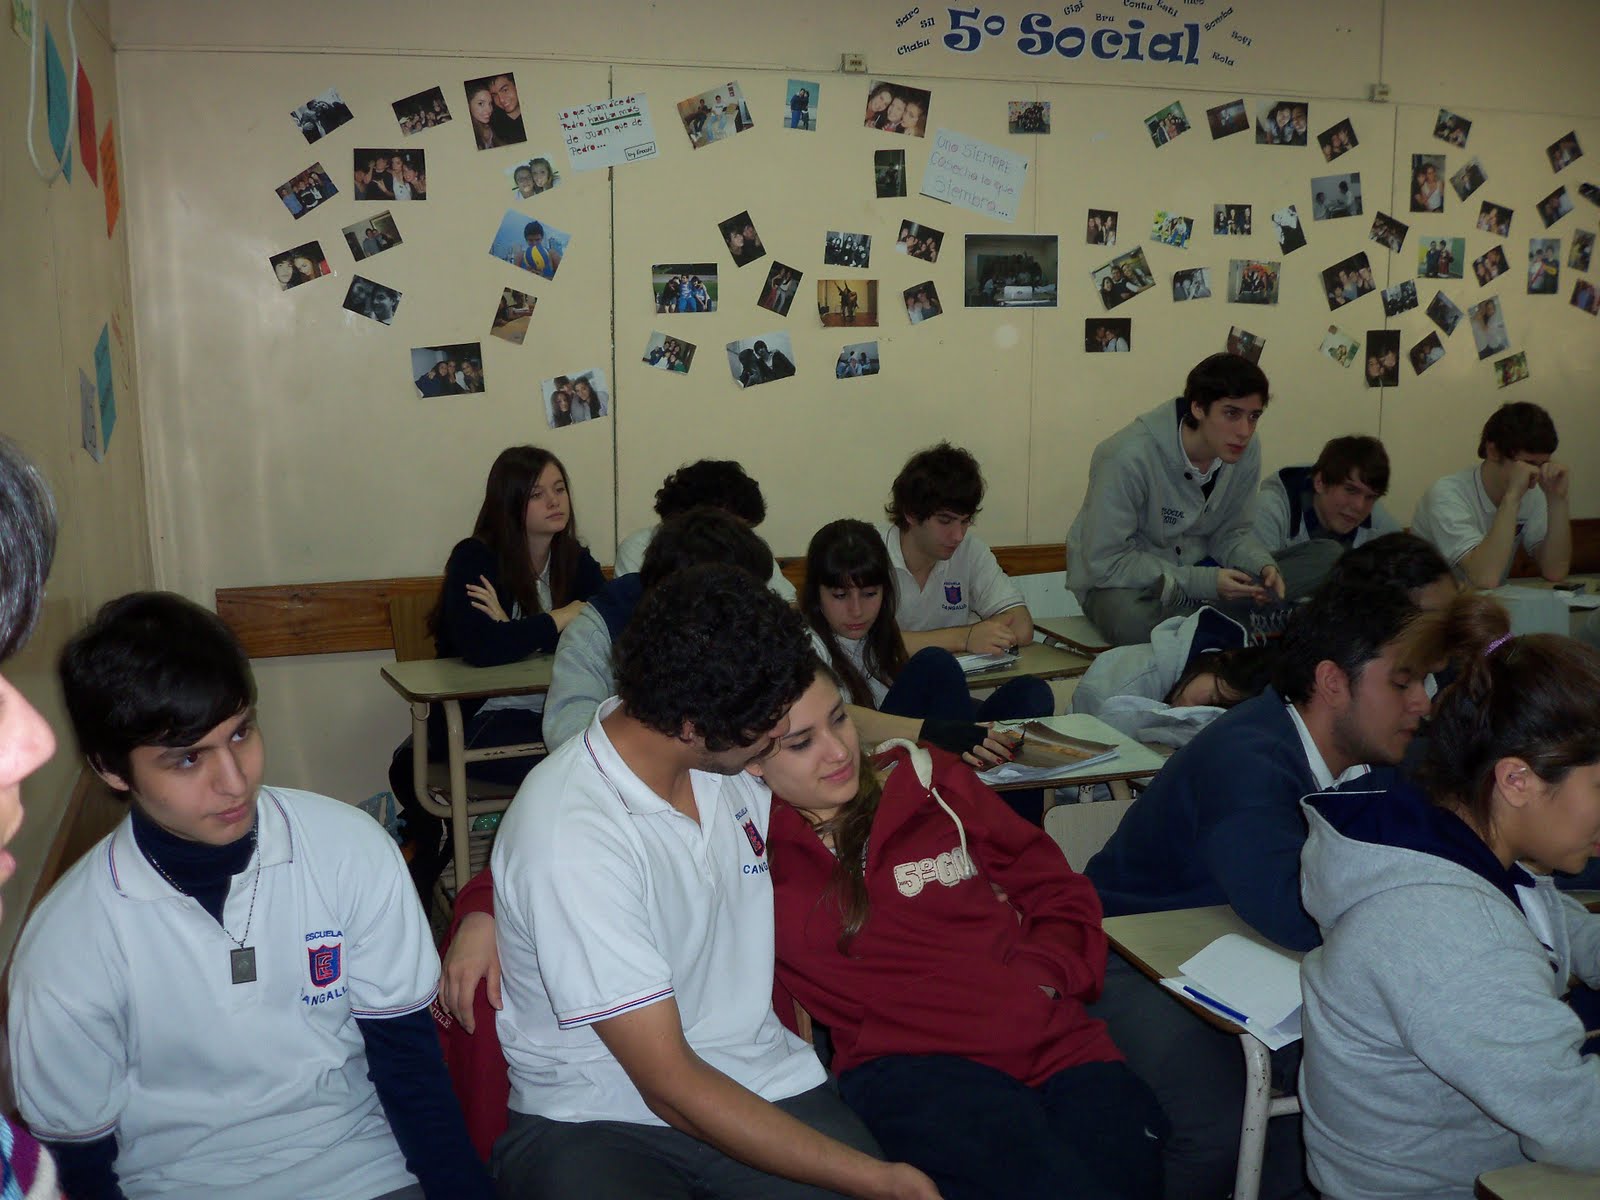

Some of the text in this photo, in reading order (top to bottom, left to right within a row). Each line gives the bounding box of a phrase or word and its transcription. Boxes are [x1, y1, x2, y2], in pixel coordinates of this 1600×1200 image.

[1095, 13, 1115, 22] Bru
[1017, 13, 1200, 65] Social
[897, 38, 931, 56] Chabu
[587, 103, 608, 114] Juan
[585, 127, 610, 140] Juan
[305, 930, 343, 942] ESCUELA
